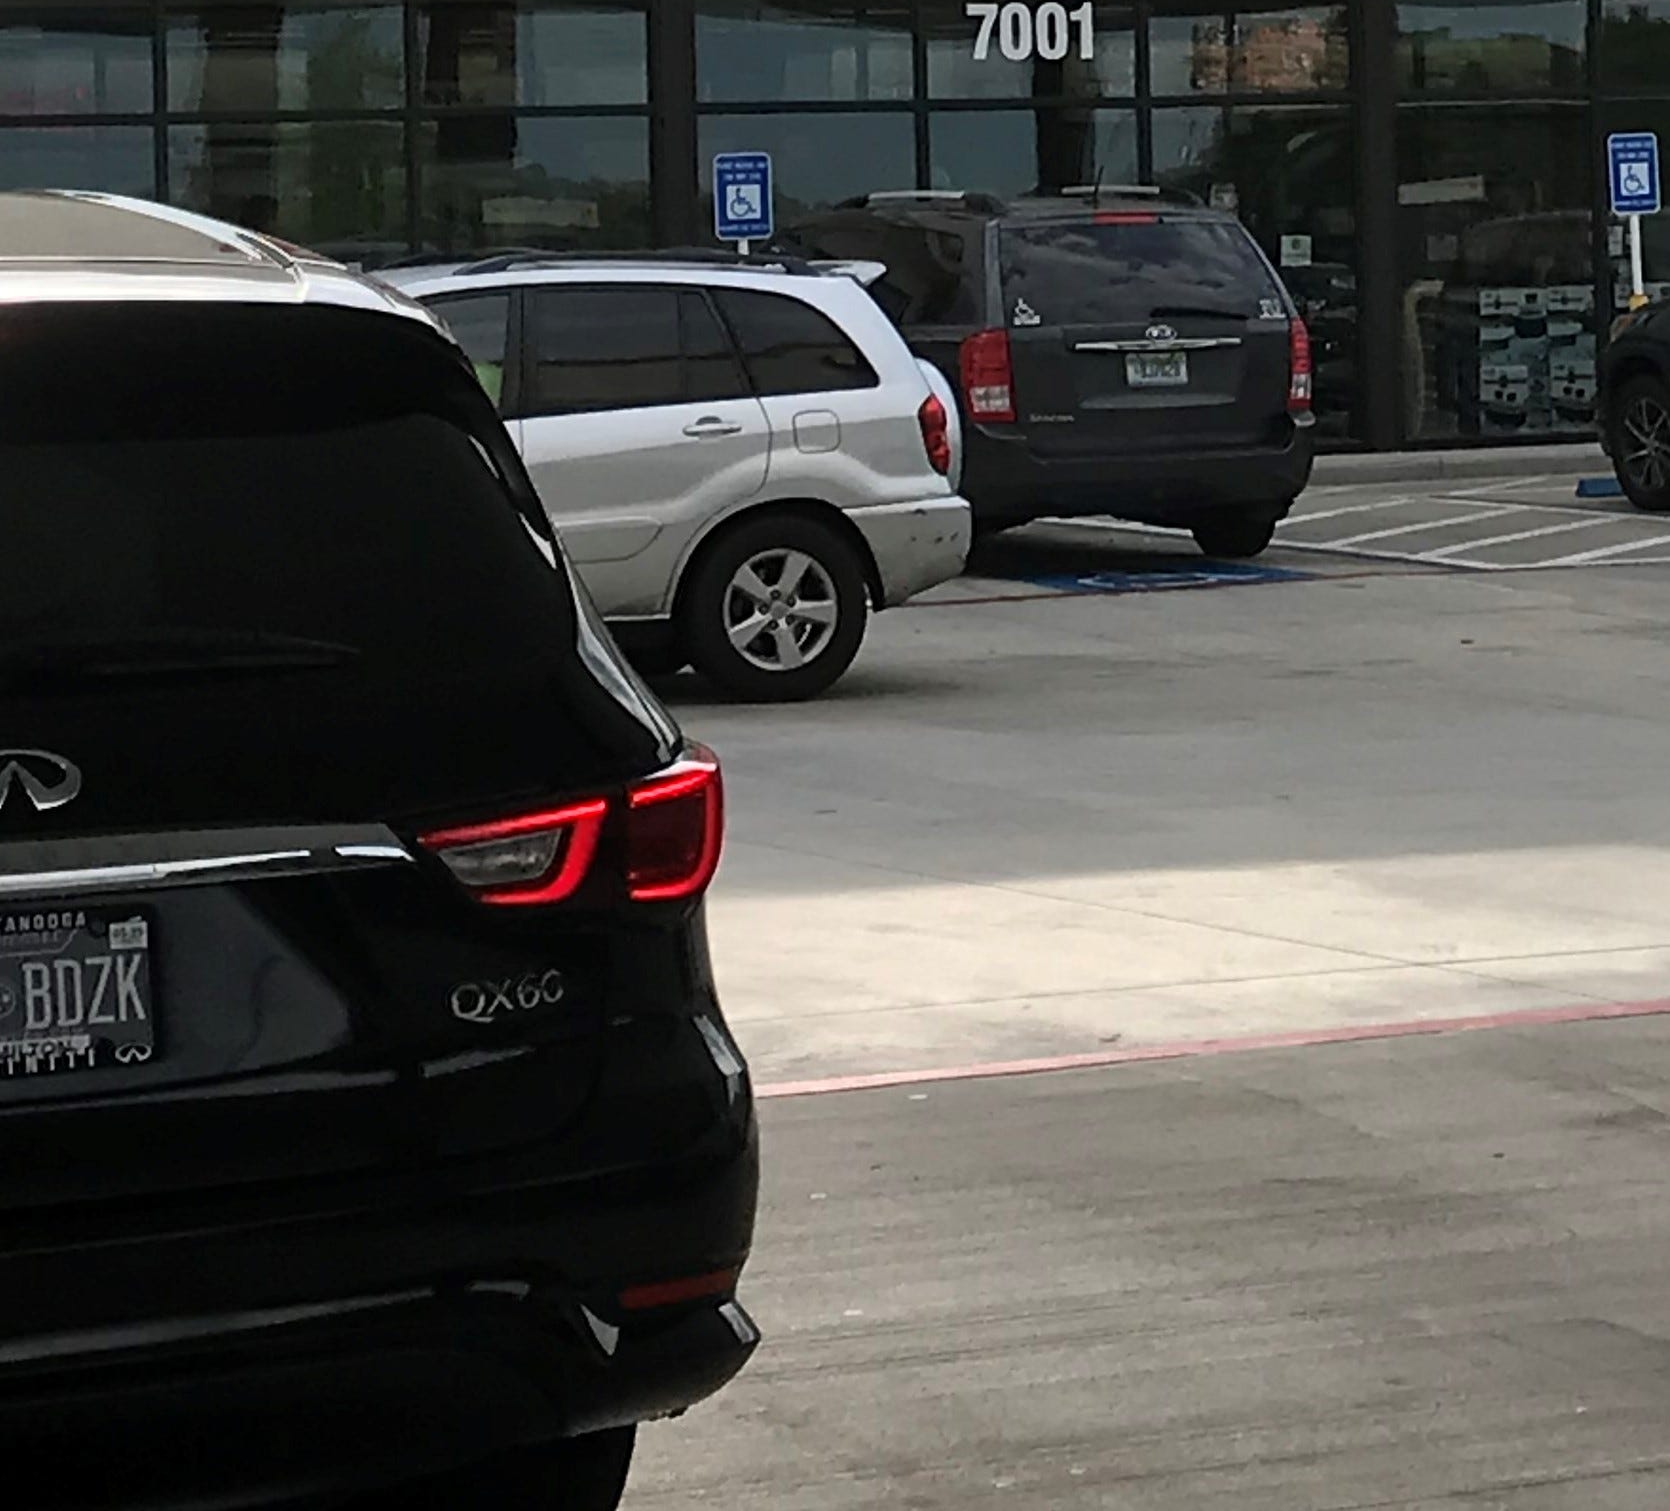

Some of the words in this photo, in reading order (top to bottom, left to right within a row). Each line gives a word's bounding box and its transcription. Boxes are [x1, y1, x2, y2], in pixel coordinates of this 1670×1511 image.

[966, 1, 1093, 60] 7001
[0, 911, 86, 932] ANOOGA
[450, 968, 564, 1023] QX60
